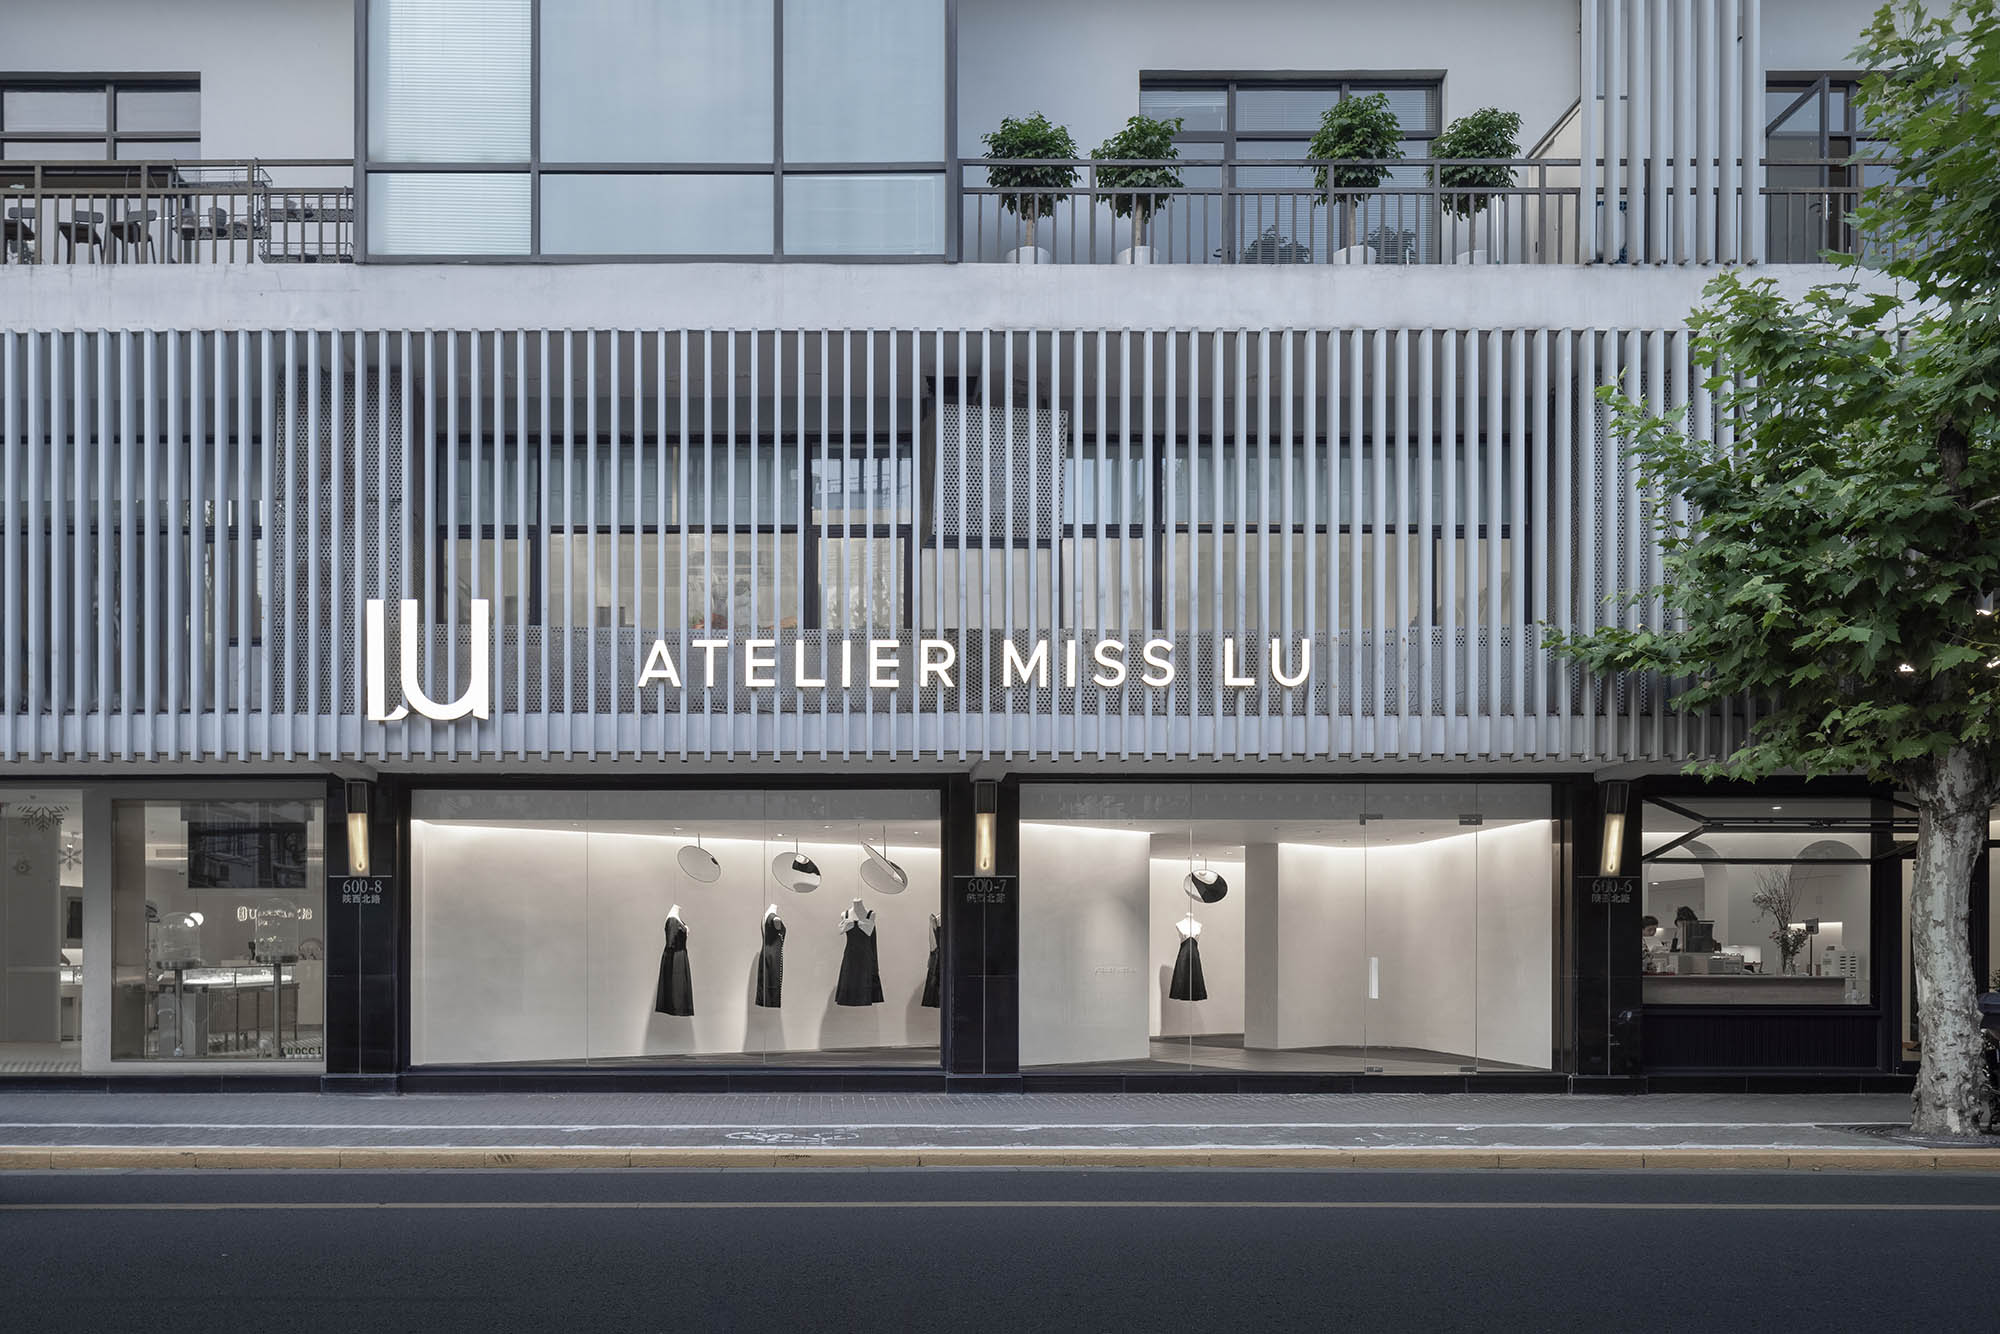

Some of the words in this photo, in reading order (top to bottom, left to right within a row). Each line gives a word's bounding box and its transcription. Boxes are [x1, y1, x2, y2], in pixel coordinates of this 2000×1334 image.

[637, 638, 956, 688] ATELIER
[1003, 638, 1175, 688] MISS
[1224, 637, 1311, 687] LU
[343, 879, 382, 893] 600-8
[968, 878, 1007, 892] 600-7
[1592, 879, 1632, 893] 600-6
